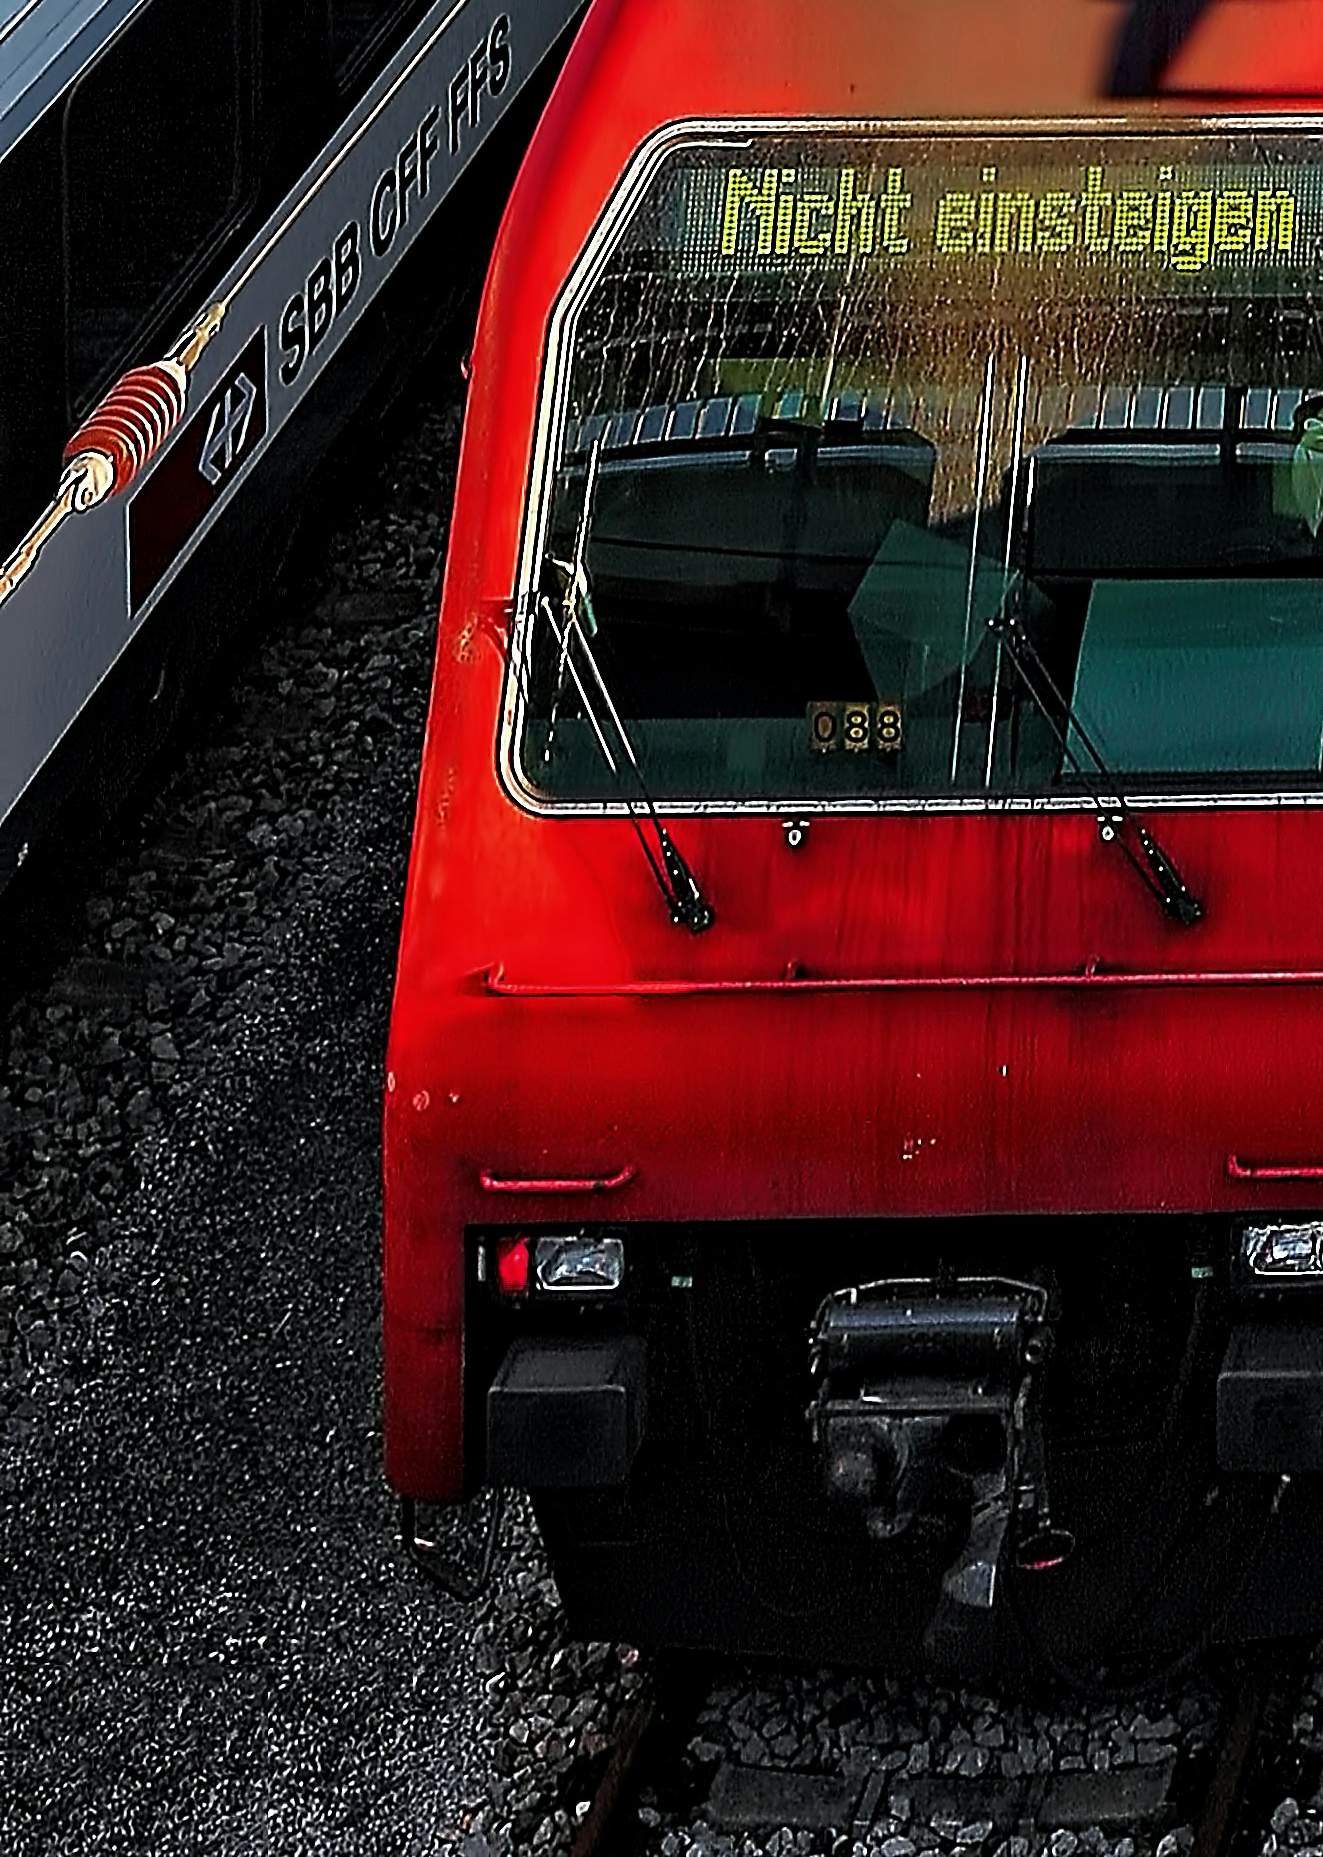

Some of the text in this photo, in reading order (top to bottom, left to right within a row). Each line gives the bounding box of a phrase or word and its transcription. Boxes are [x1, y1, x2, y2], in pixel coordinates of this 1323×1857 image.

[278, 13, 512, 387] SBB CFF FFS
[721, 165, 1295, 271] Nicht einsteigen
[813, 710, 902, 744] 088
